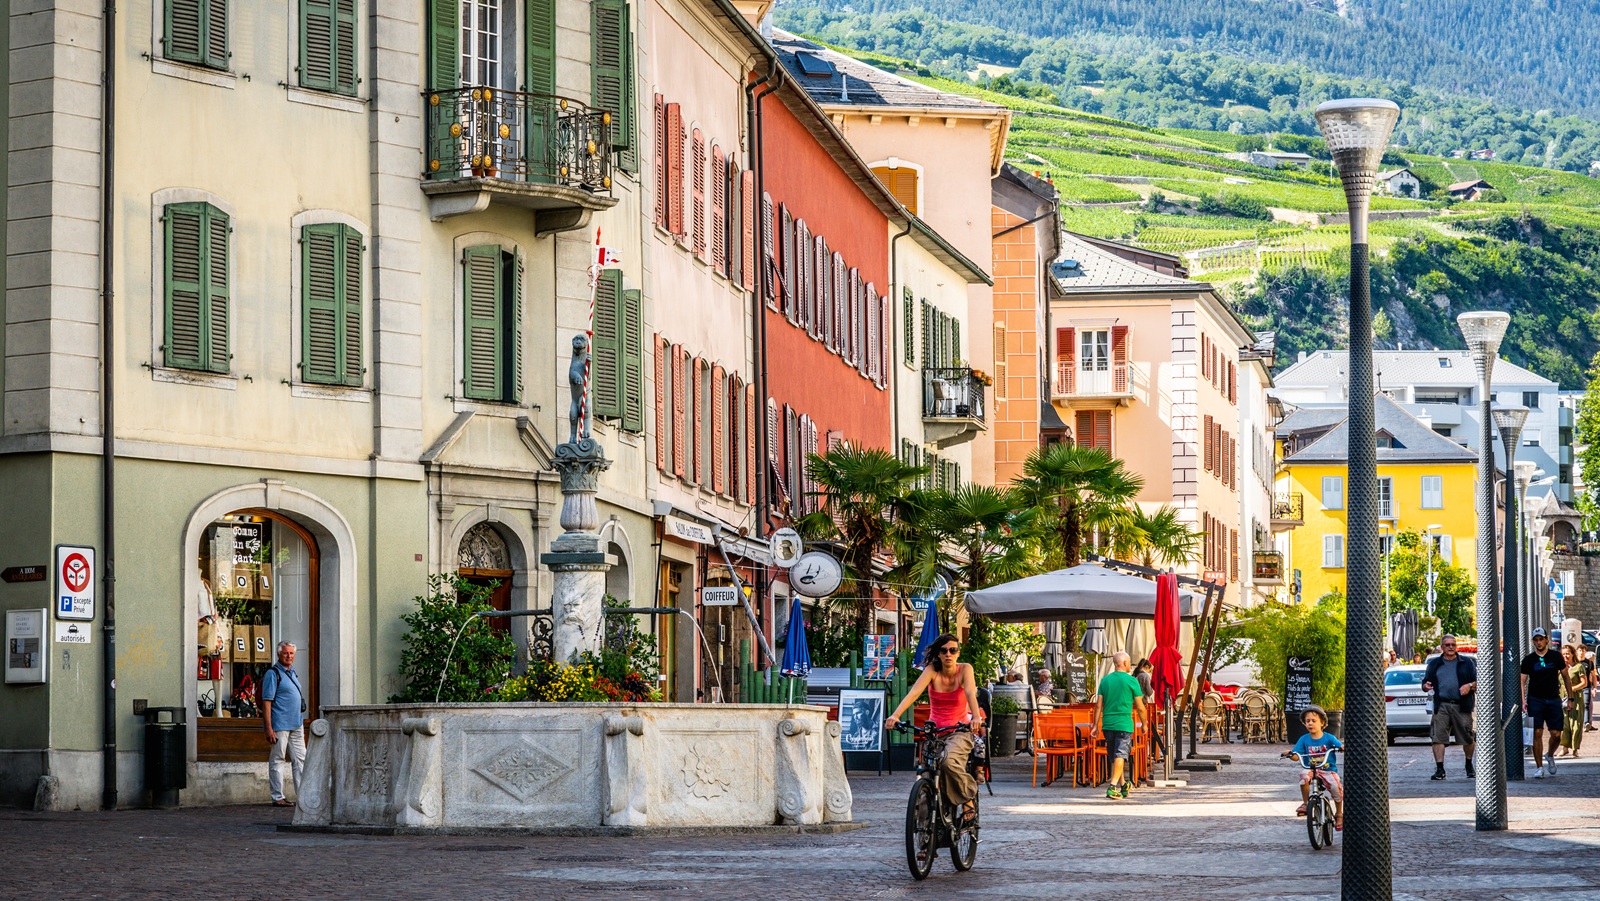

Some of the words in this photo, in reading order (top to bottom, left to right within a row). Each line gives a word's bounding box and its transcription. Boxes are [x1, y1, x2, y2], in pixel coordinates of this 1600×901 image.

[233, 527, 258, 537] comme
[233, 540, 244, 549] un
[705, 592, 735, 601] COIFFEUR
[74, 597, 91, 606] Excepté
